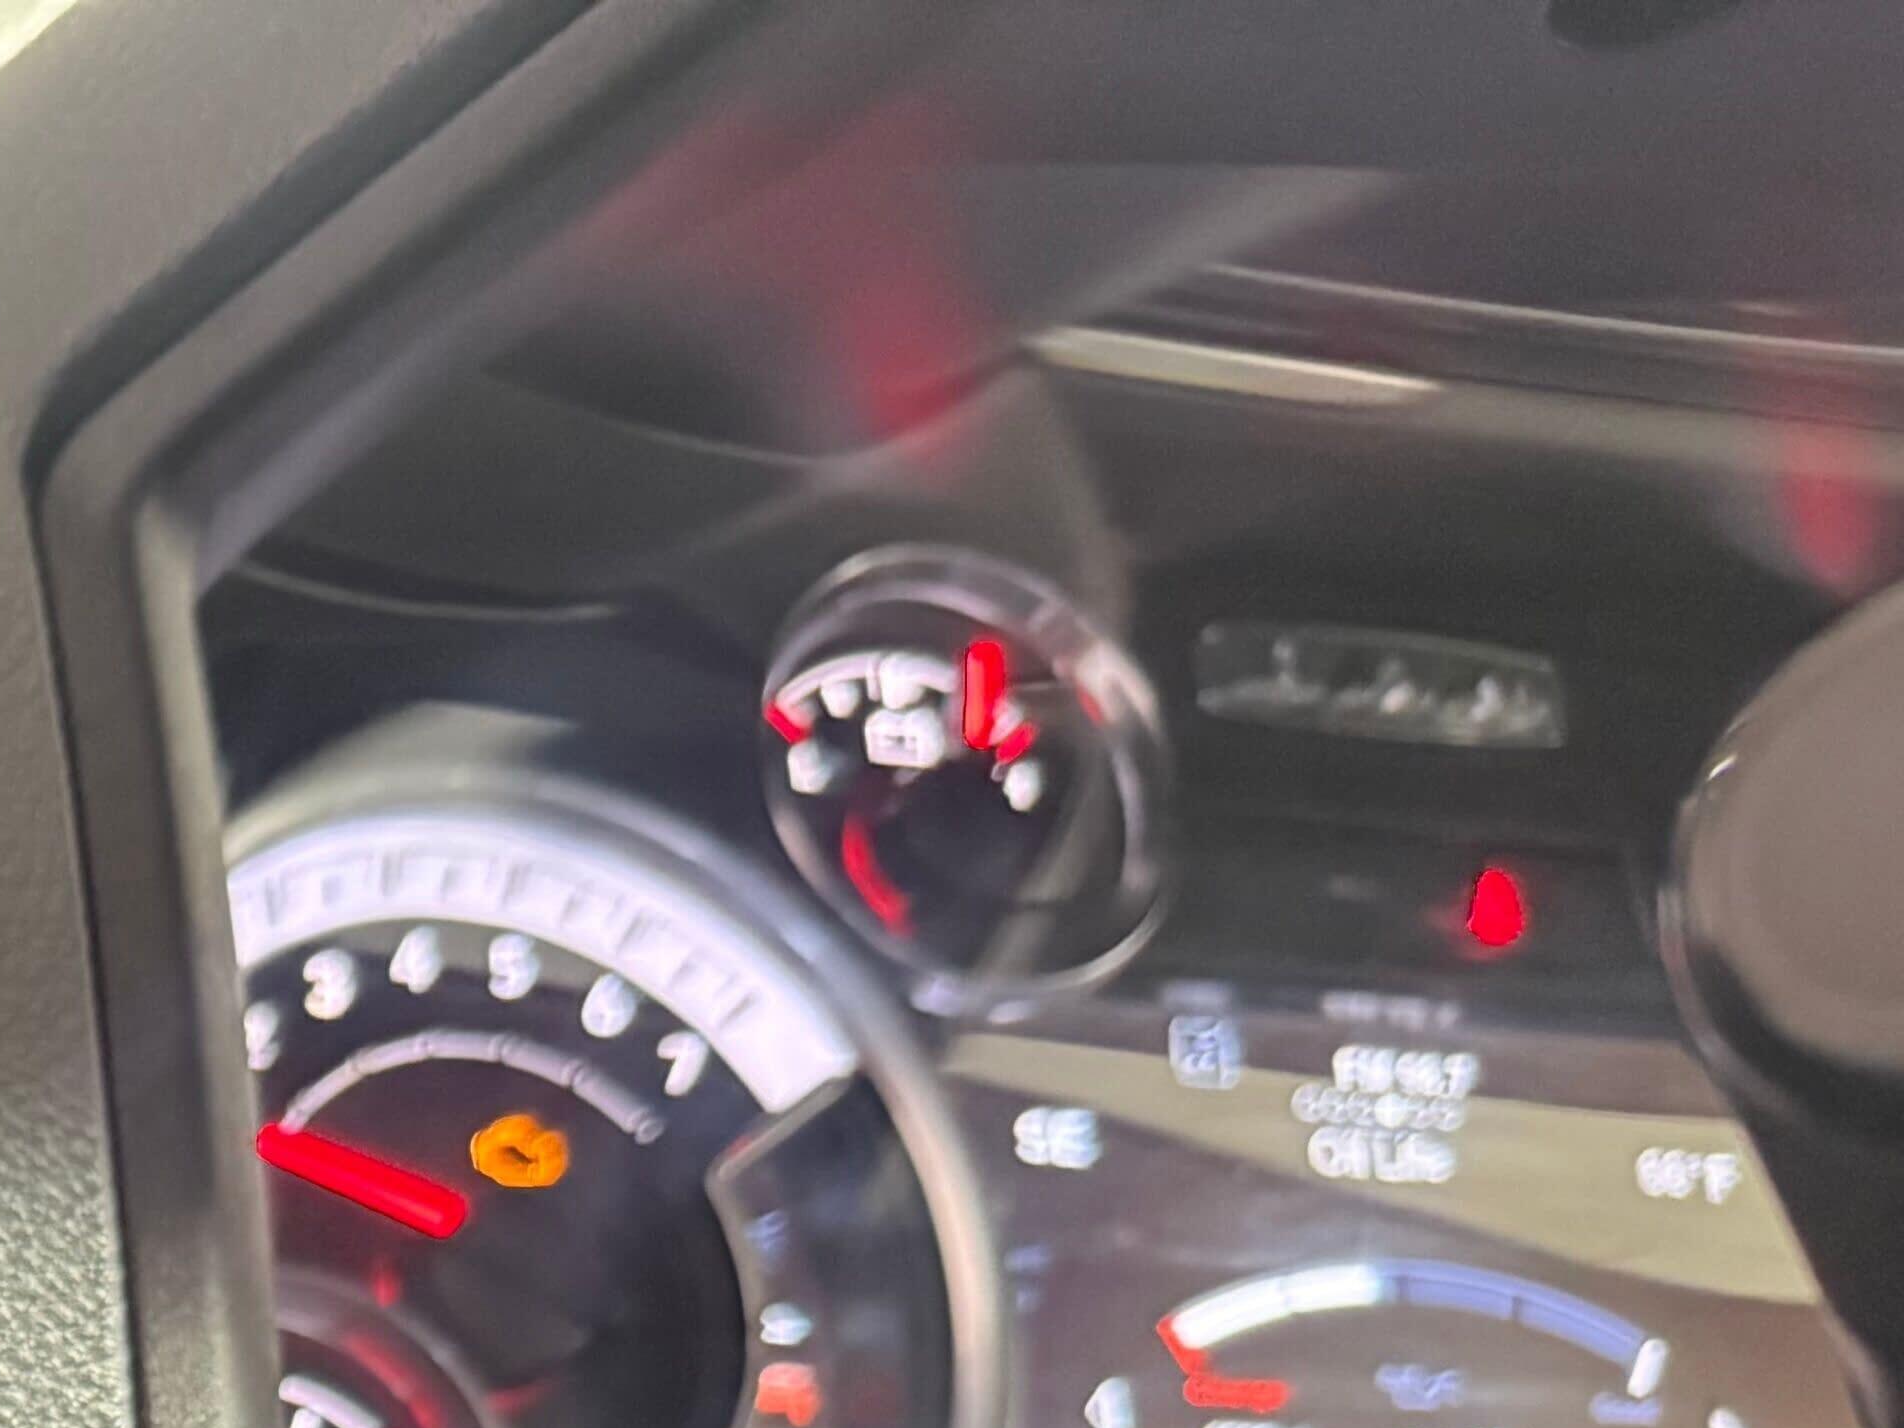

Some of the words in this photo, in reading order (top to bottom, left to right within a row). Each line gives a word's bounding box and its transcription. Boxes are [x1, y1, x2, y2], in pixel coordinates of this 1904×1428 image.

[302, 947, 359, 1021] 3
[389, 926, 443, 994] 4
[489, 933, 540, 1001] 5
[657, 1031, 711, 1097] 7
